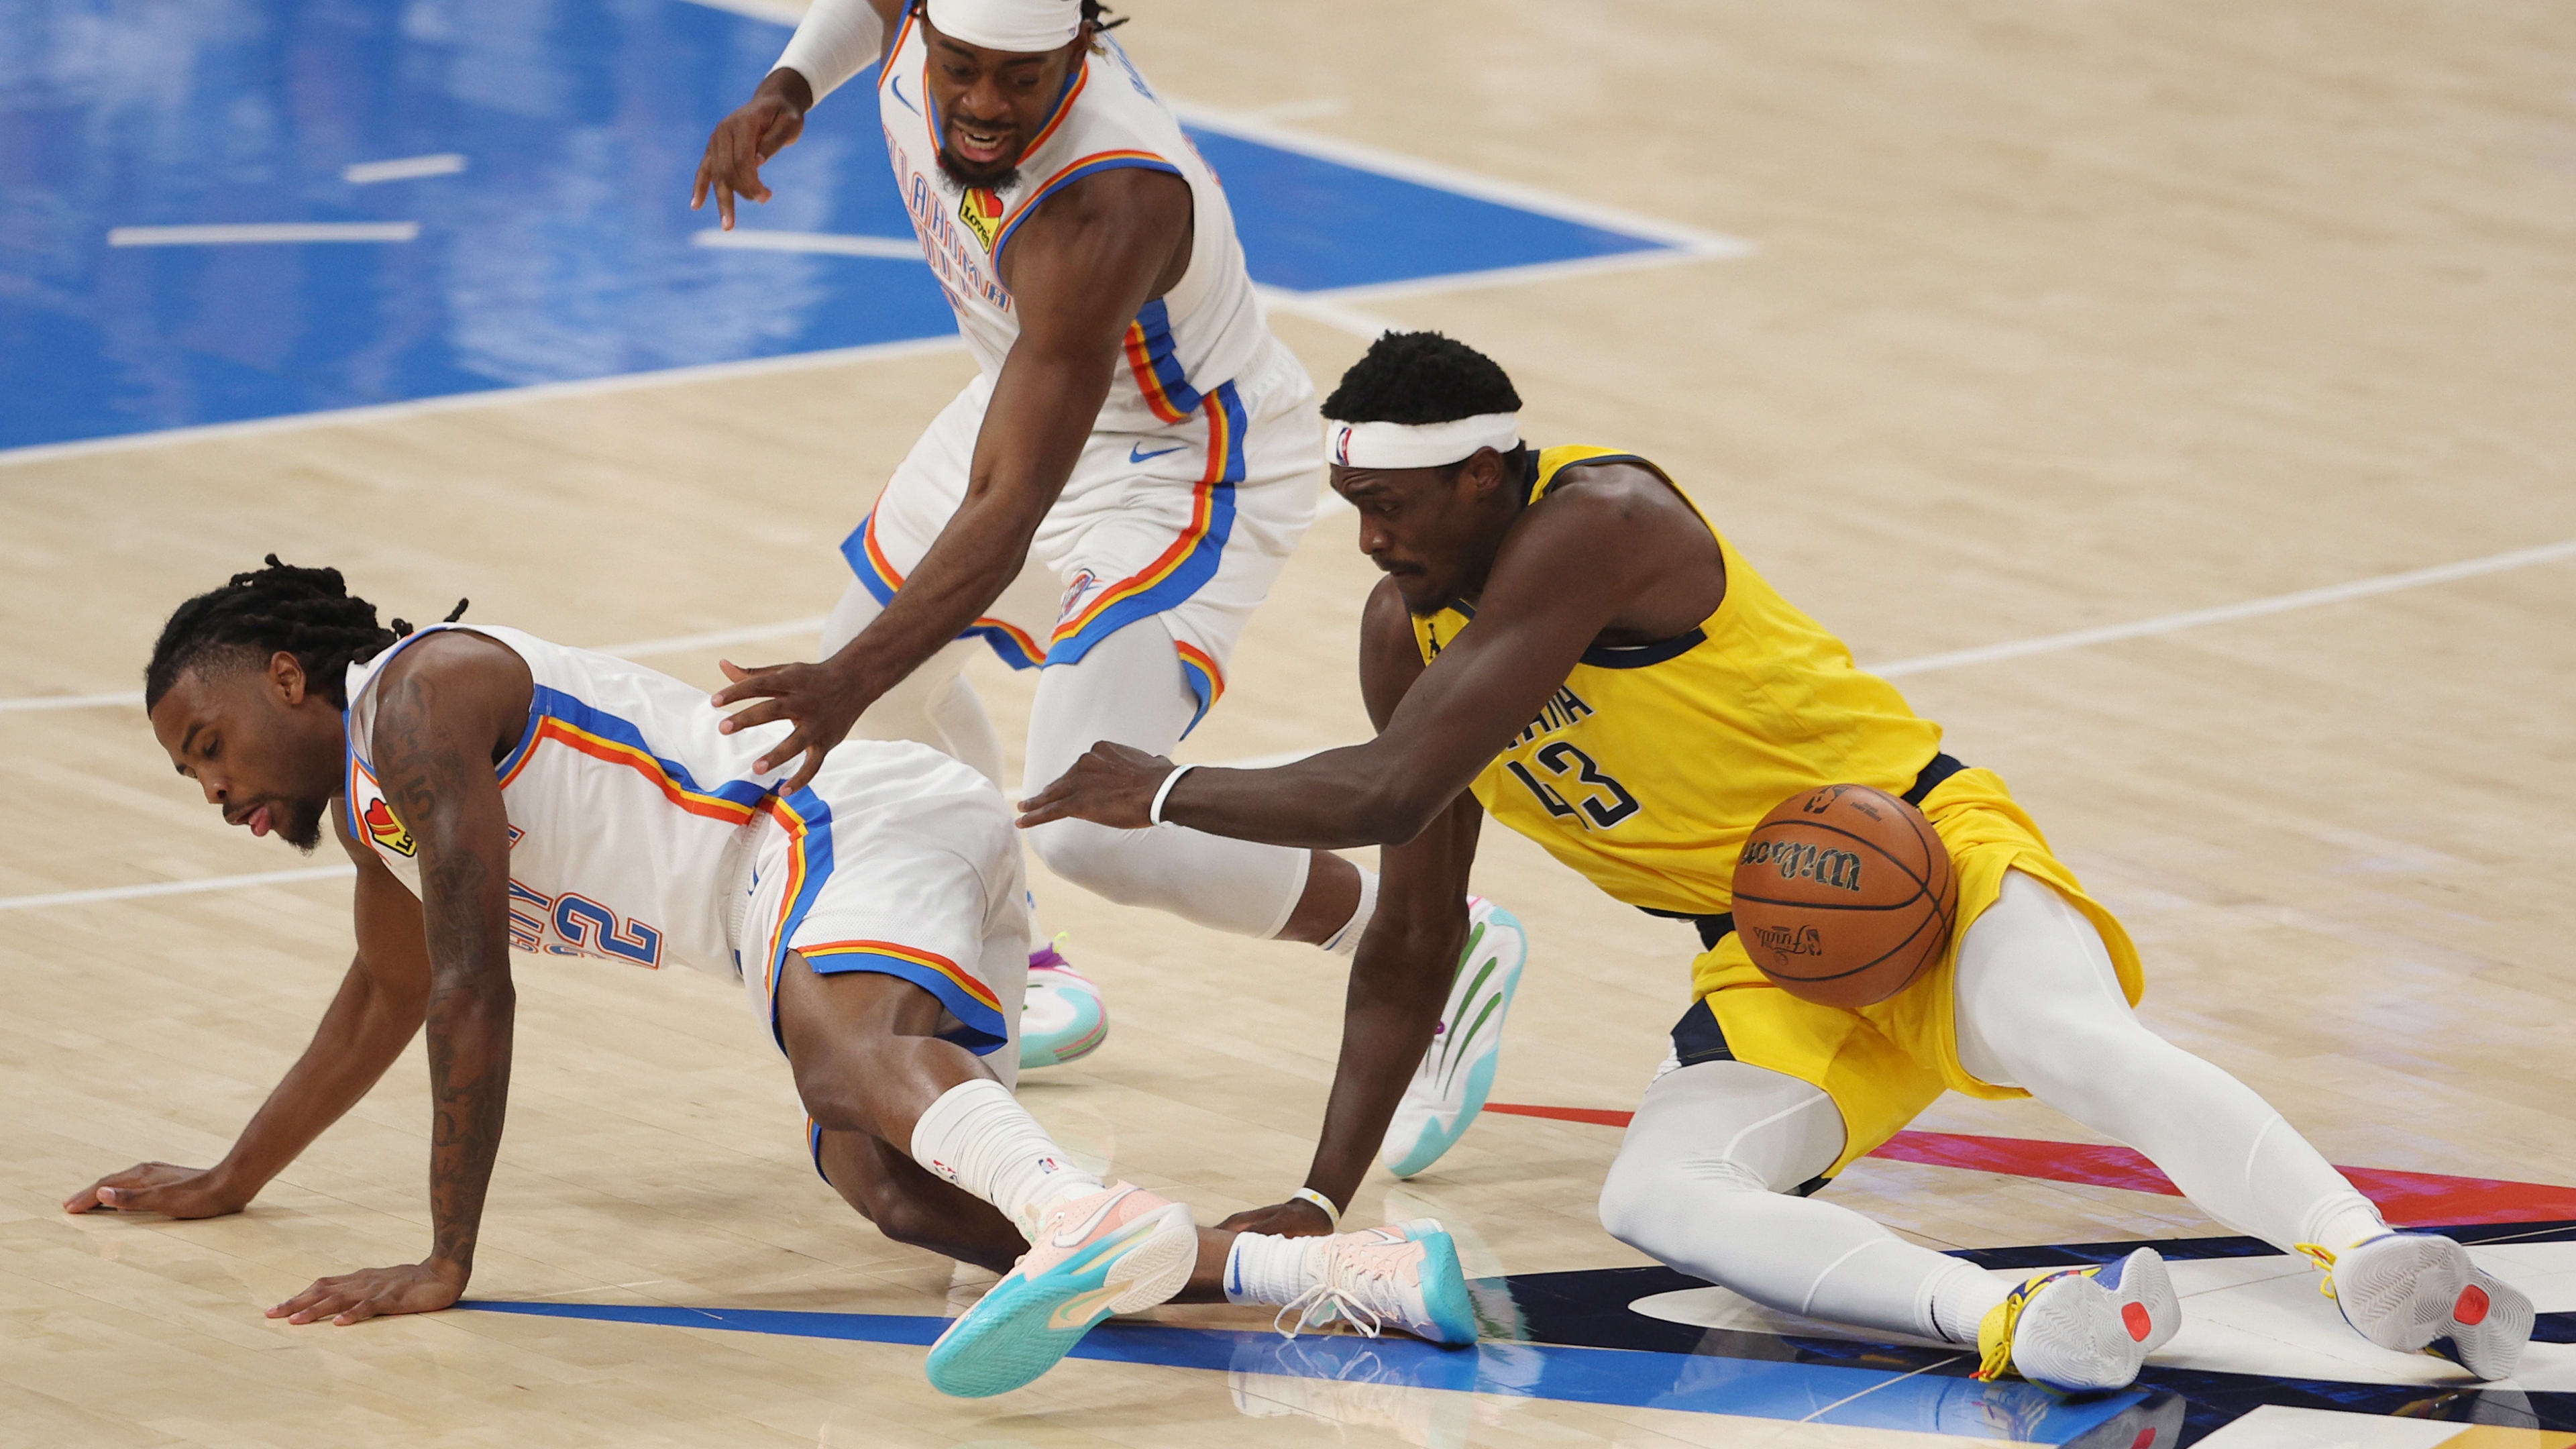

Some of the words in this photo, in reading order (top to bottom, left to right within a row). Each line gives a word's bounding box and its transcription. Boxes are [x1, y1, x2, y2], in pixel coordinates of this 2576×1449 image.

[1505, 741, 1642, 833] 43
[1740, 840, 1862, 893] Wilson
[1752, 924, 1812, 955] Finals
